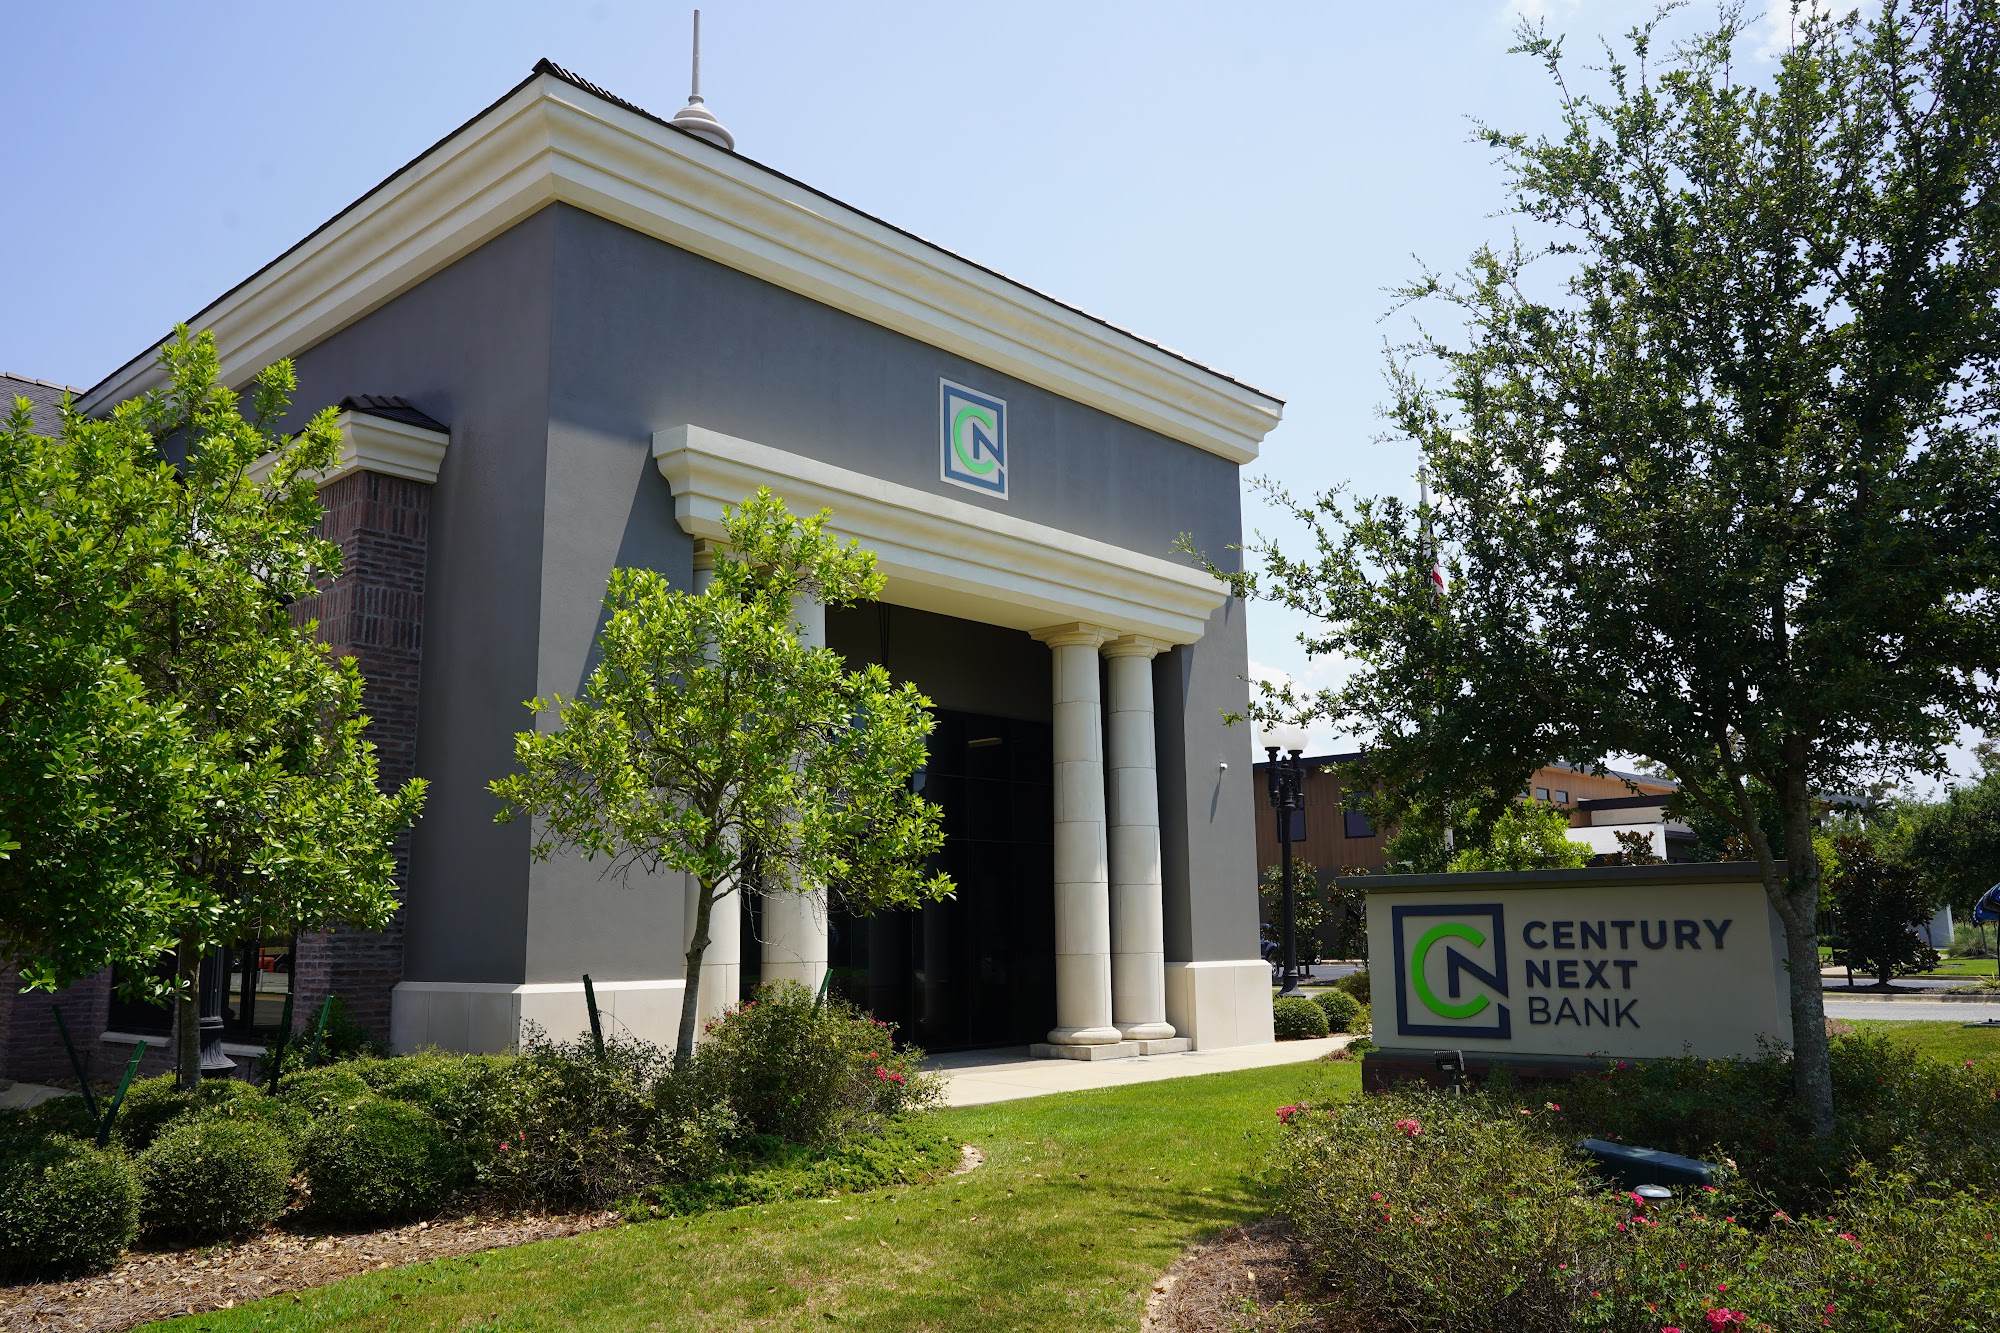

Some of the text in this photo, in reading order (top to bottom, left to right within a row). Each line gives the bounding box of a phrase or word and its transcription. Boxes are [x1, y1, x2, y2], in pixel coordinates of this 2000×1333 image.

[1522, 919, 1732, 950] CENTURY
[1525, 959, 1638, 989] NEXT
[1529, 996, 1641, 1029] BANK
